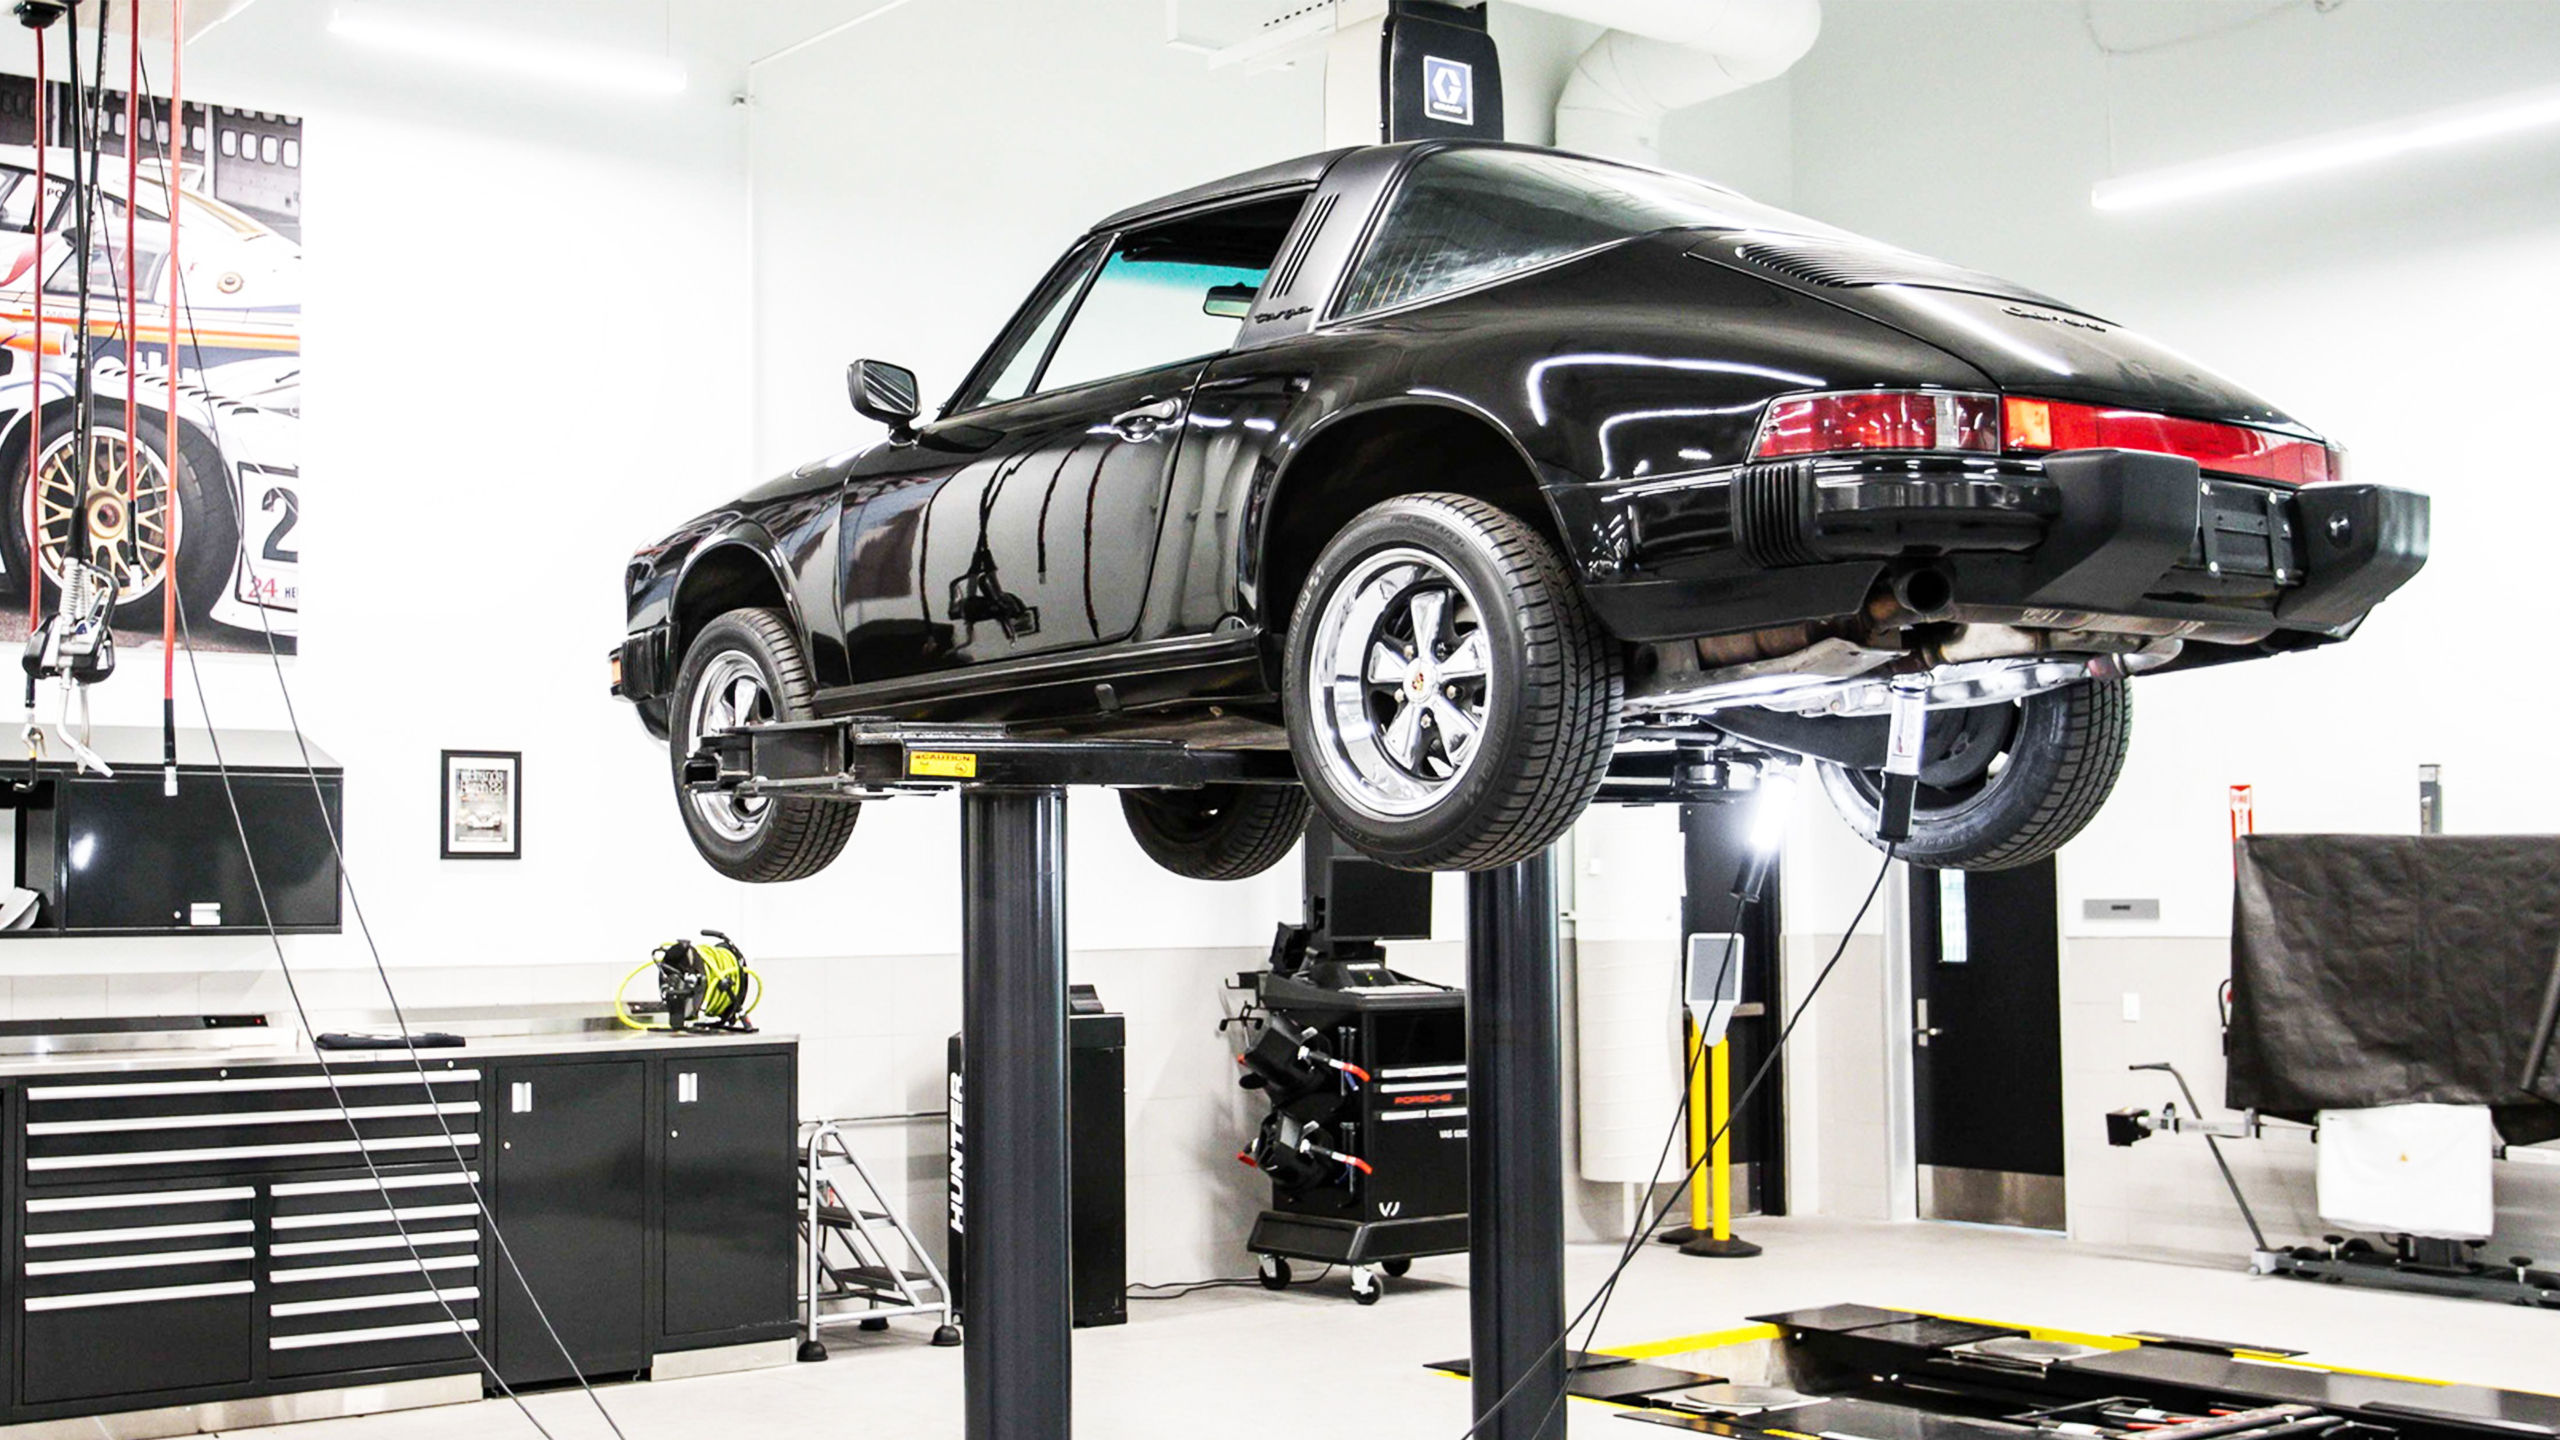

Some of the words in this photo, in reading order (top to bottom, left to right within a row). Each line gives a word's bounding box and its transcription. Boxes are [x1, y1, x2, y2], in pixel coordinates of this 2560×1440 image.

[248, 577, 278, 598] 24
[921, 753, 971, 761] CAUTION
[1394, 1093, 1454, 1105] PORSCHE
[949, 1071, 965, 1234] HUNTER
